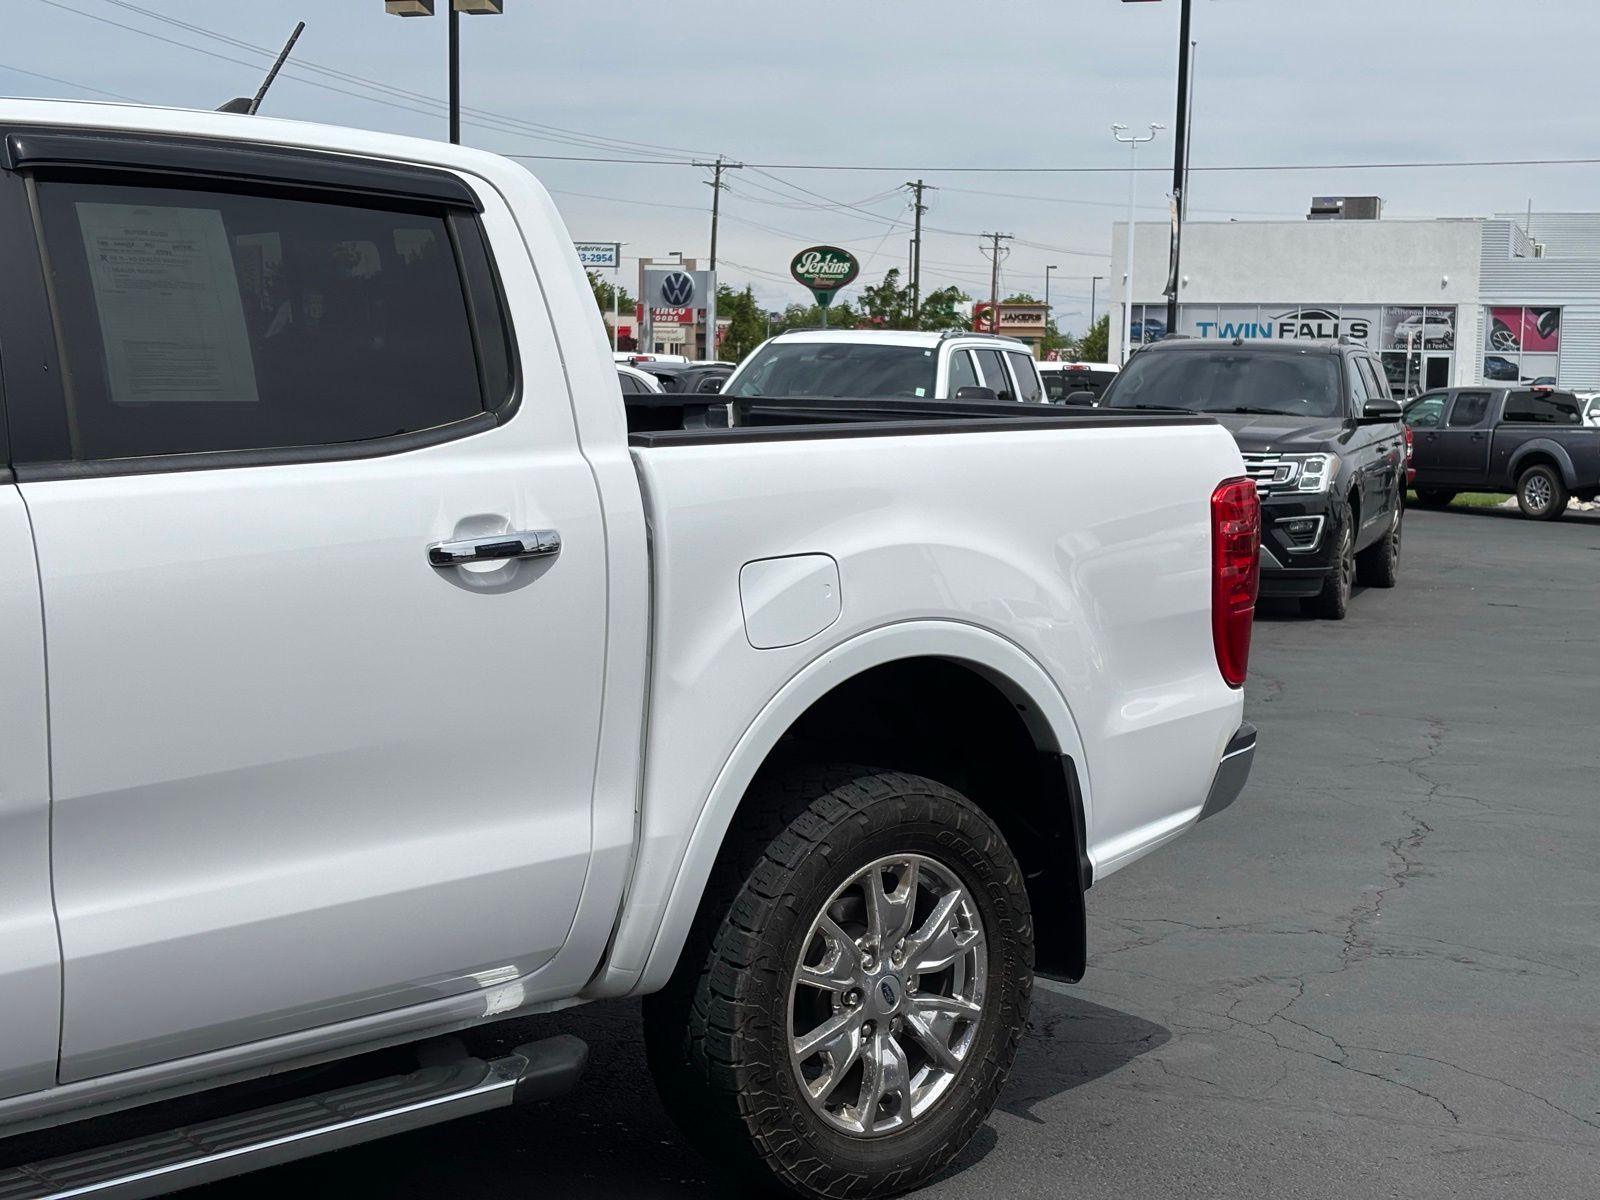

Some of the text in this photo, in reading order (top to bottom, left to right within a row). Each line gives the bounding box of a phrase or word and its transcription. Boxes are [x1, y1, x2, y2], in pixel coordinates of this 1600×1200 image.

[579, 252, 613, 262] 3-2954
[796, 251, 851, 274] Perkins
[1001, 313, 1042, 321] JAKERS
[1196, 322, 1369, 339] TWIN FALLS
